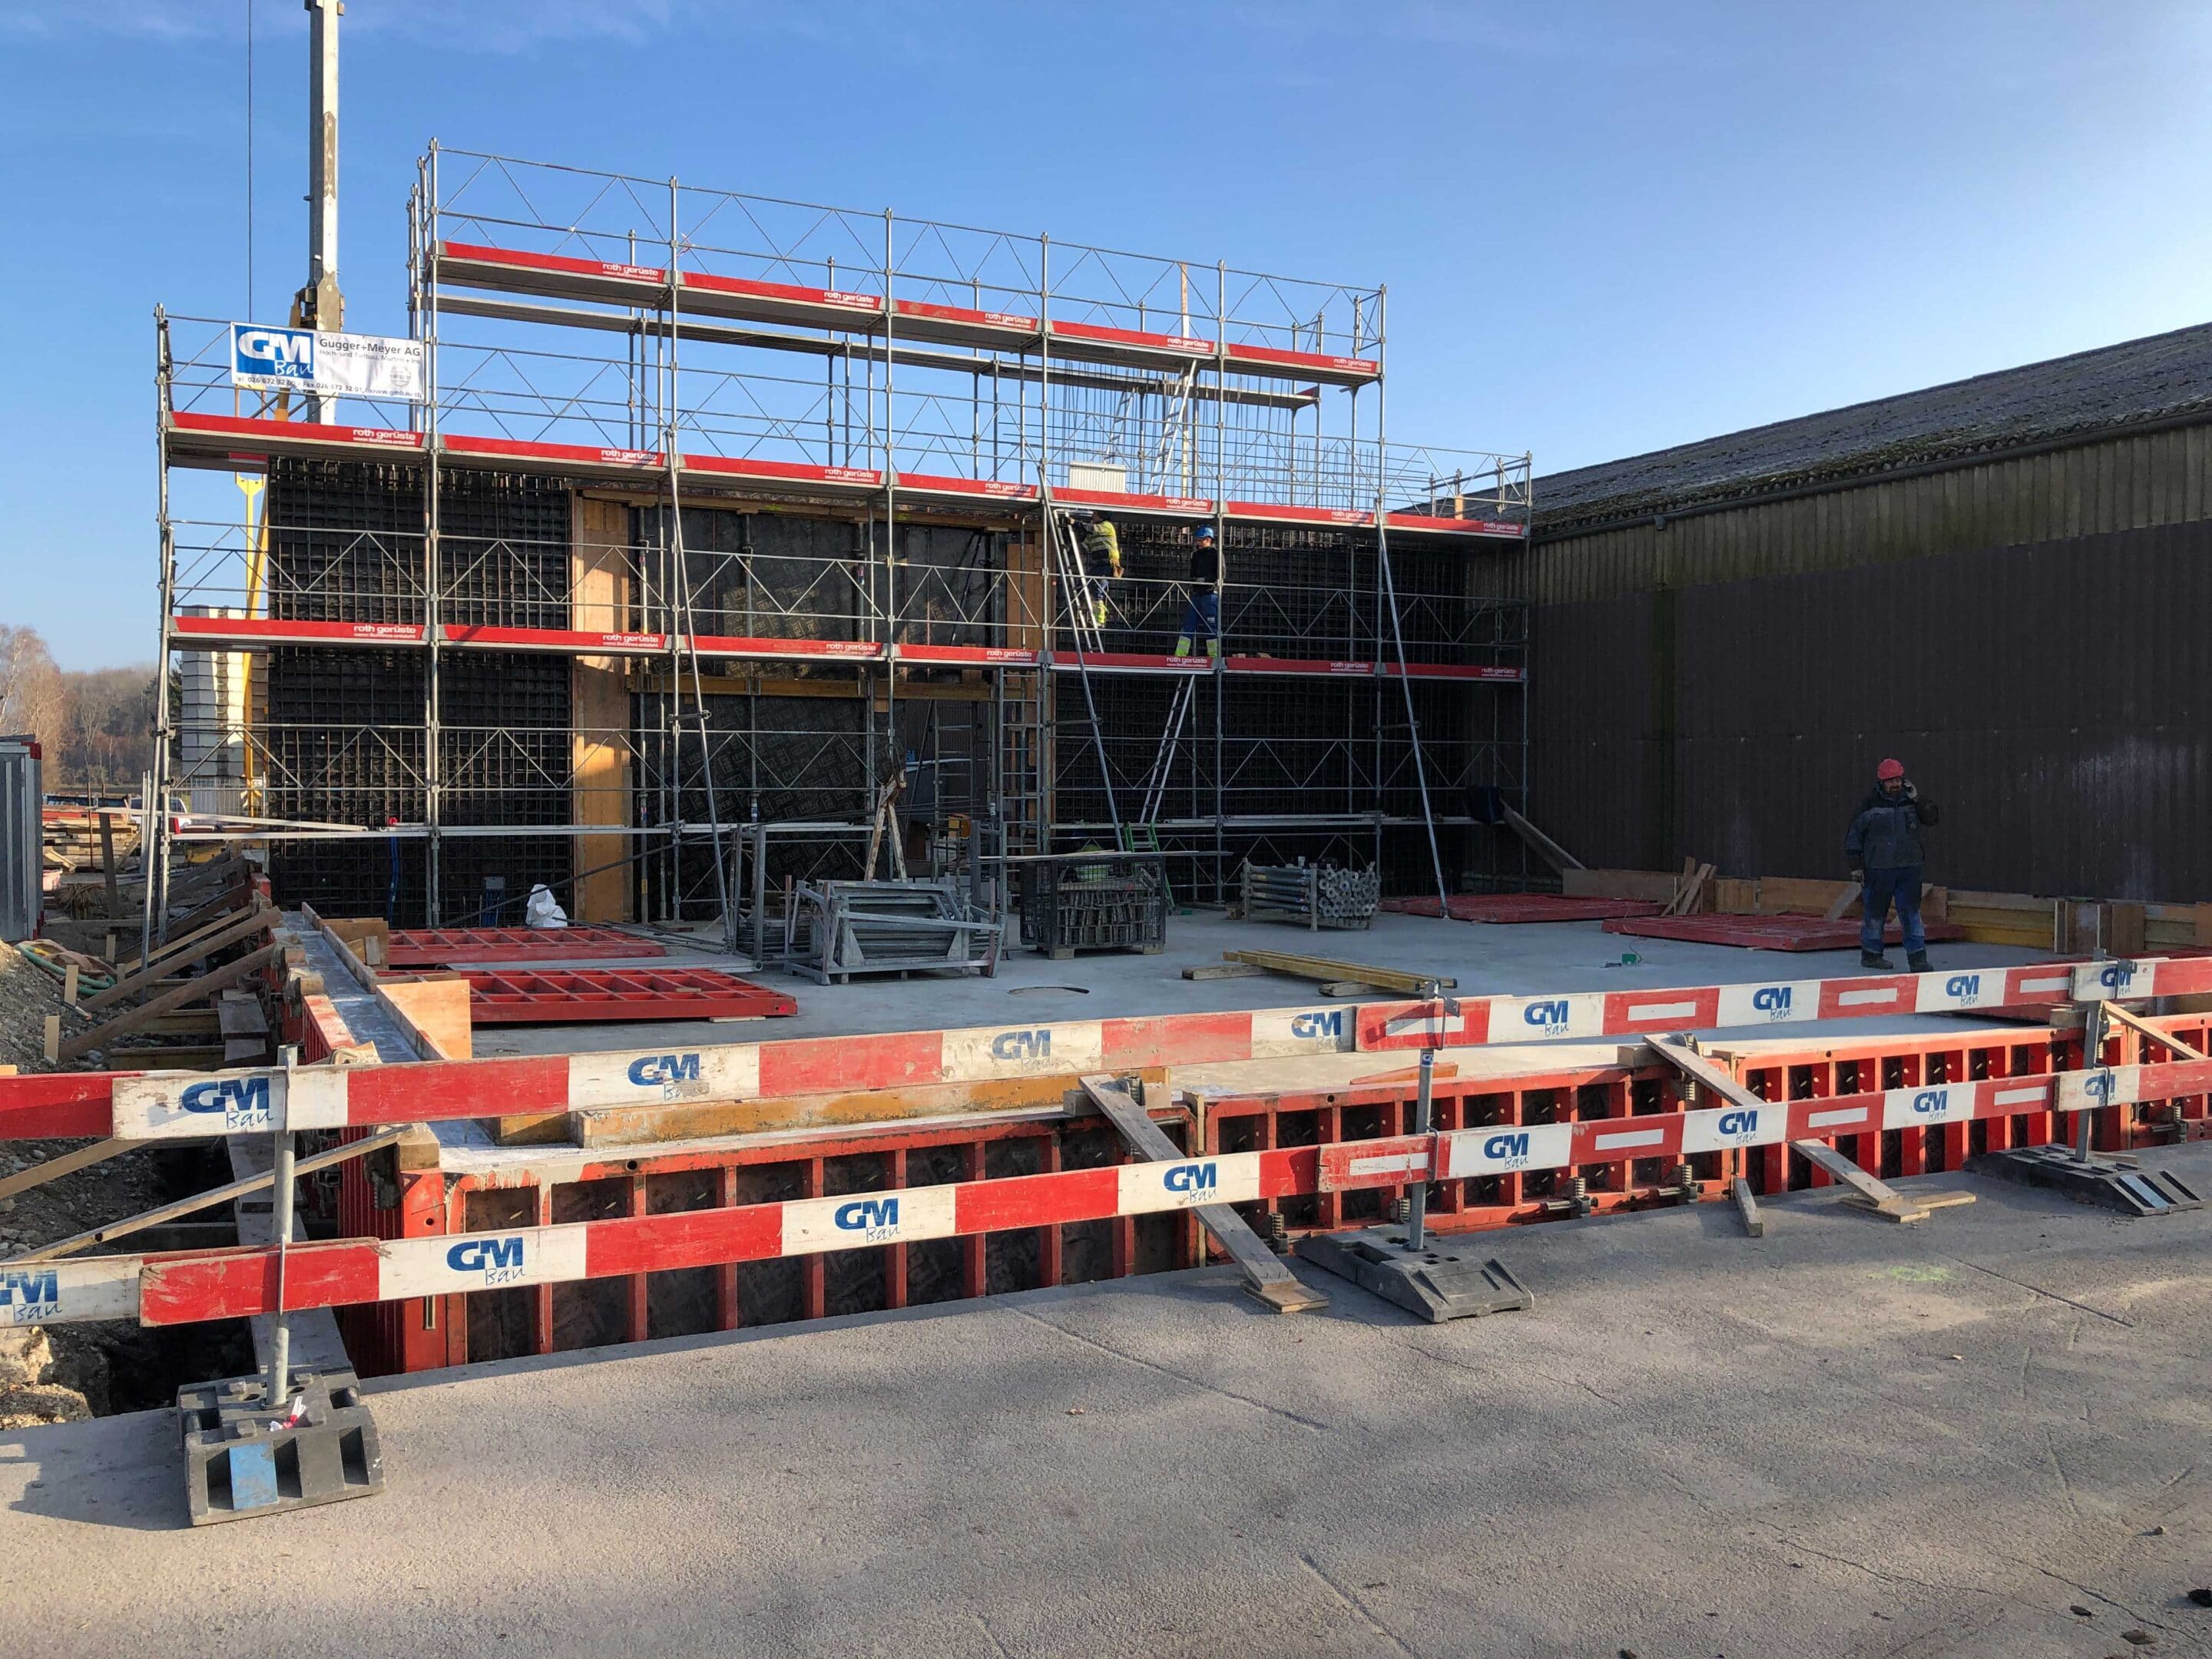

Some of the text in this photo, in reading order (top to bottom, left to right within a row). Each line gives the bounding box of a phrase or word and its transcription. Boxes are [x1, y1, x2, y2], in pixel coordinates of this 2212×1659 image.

[623, 266, 658, 276] gerüste
[238, 330, 311, 364] GM
[320, 338, 421, 356] Gugger+Meyer AG
[274, 359, 314, 376] Bau
[376, 431, 416, 440] gerüste
[376, 625, 416, 634] gerüste
[1945, 975, 1980, 996] GM
[1753, 987, 1792, 1010] GM
[1960, 995, 1979, 1007] Bau
[1524, 1000, 1569, 1025] GM
[1770, 1008, 1791, 1021] Bau
[1291, 1011, 1342, 1038] GM
[1545, 1022, 1570, 1038] Bau
[992, 1029, 1051, 1059] GM
[628, 1053, 700, 1085] GM
[182, 1077, 270, 1113] GM
[1913, 1091, 1948, 1113] GM
[226, 1108, 274, 1130] Bau
[1718, 1110, 1758, 1134] GM
[1929, 1110, 1946, 1122] Bau
[1484, 1133, 1529, 1159] GM
[1736, 1131, 1757, 1144] Bau
[1504, 1155, 1529, 1170] Bau
[1163, 1163, 1217, 1191] GM
[1189, 1187, 1217, 1204] Bau
[835, 1198, 899, 1230] GM
[866, 1226, 901, 1243] Bau
[446, 1237, 524, 1271] GM
[485, 1266, 527, 1286] Bau
[12, 1302, 63, 1322] Bau
